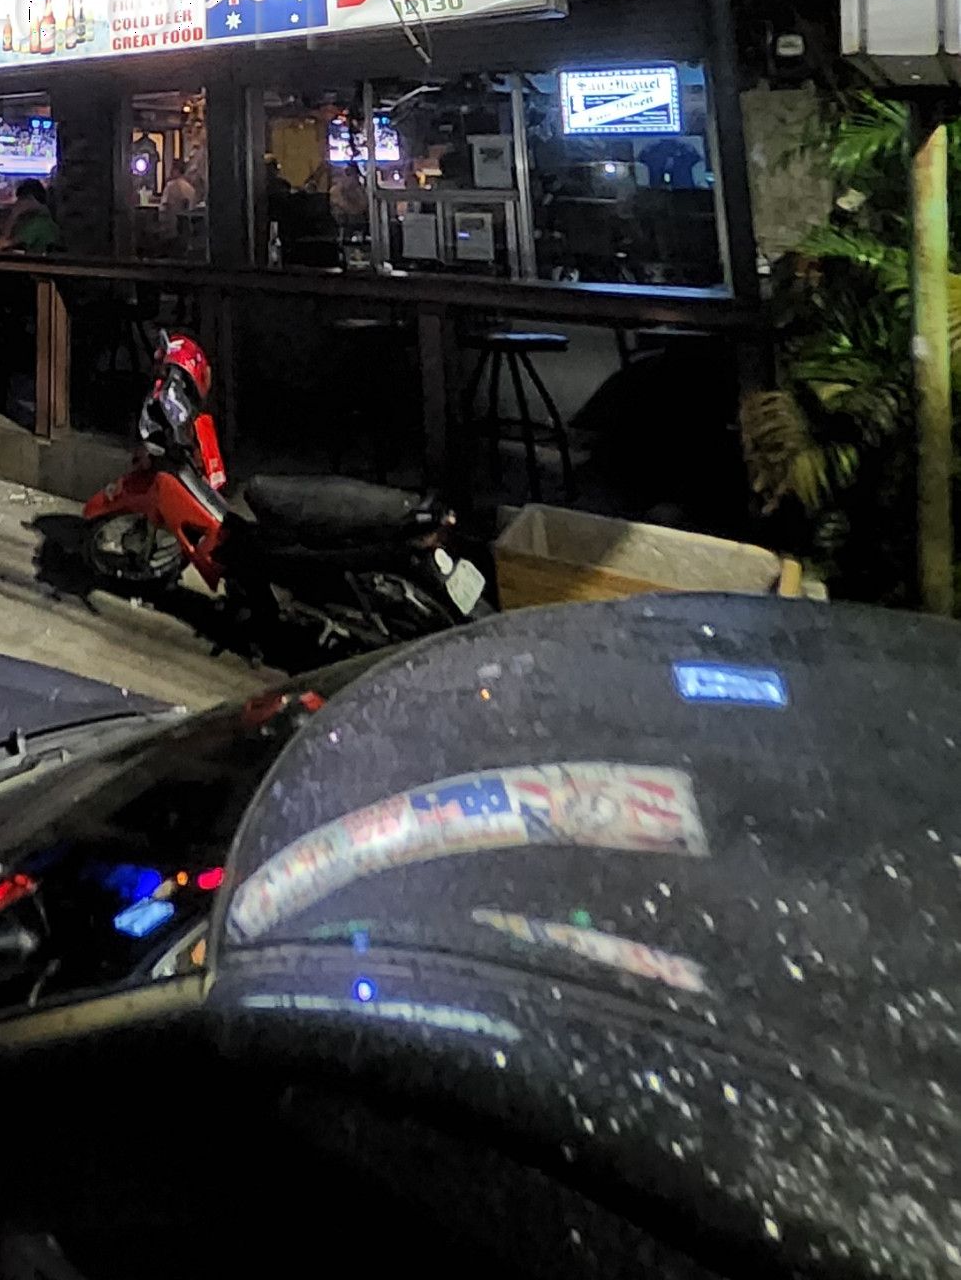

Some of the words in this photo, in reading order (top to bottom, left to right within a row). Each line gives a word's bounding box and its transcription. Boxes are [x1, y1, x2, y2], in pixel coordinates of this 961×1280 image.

[112, 15, 150, 32] COLD
[155, 9, 193, 26] BEER
[112, 33, 158, 51] GREAT
[162, 26, 203, 45] FOOD
